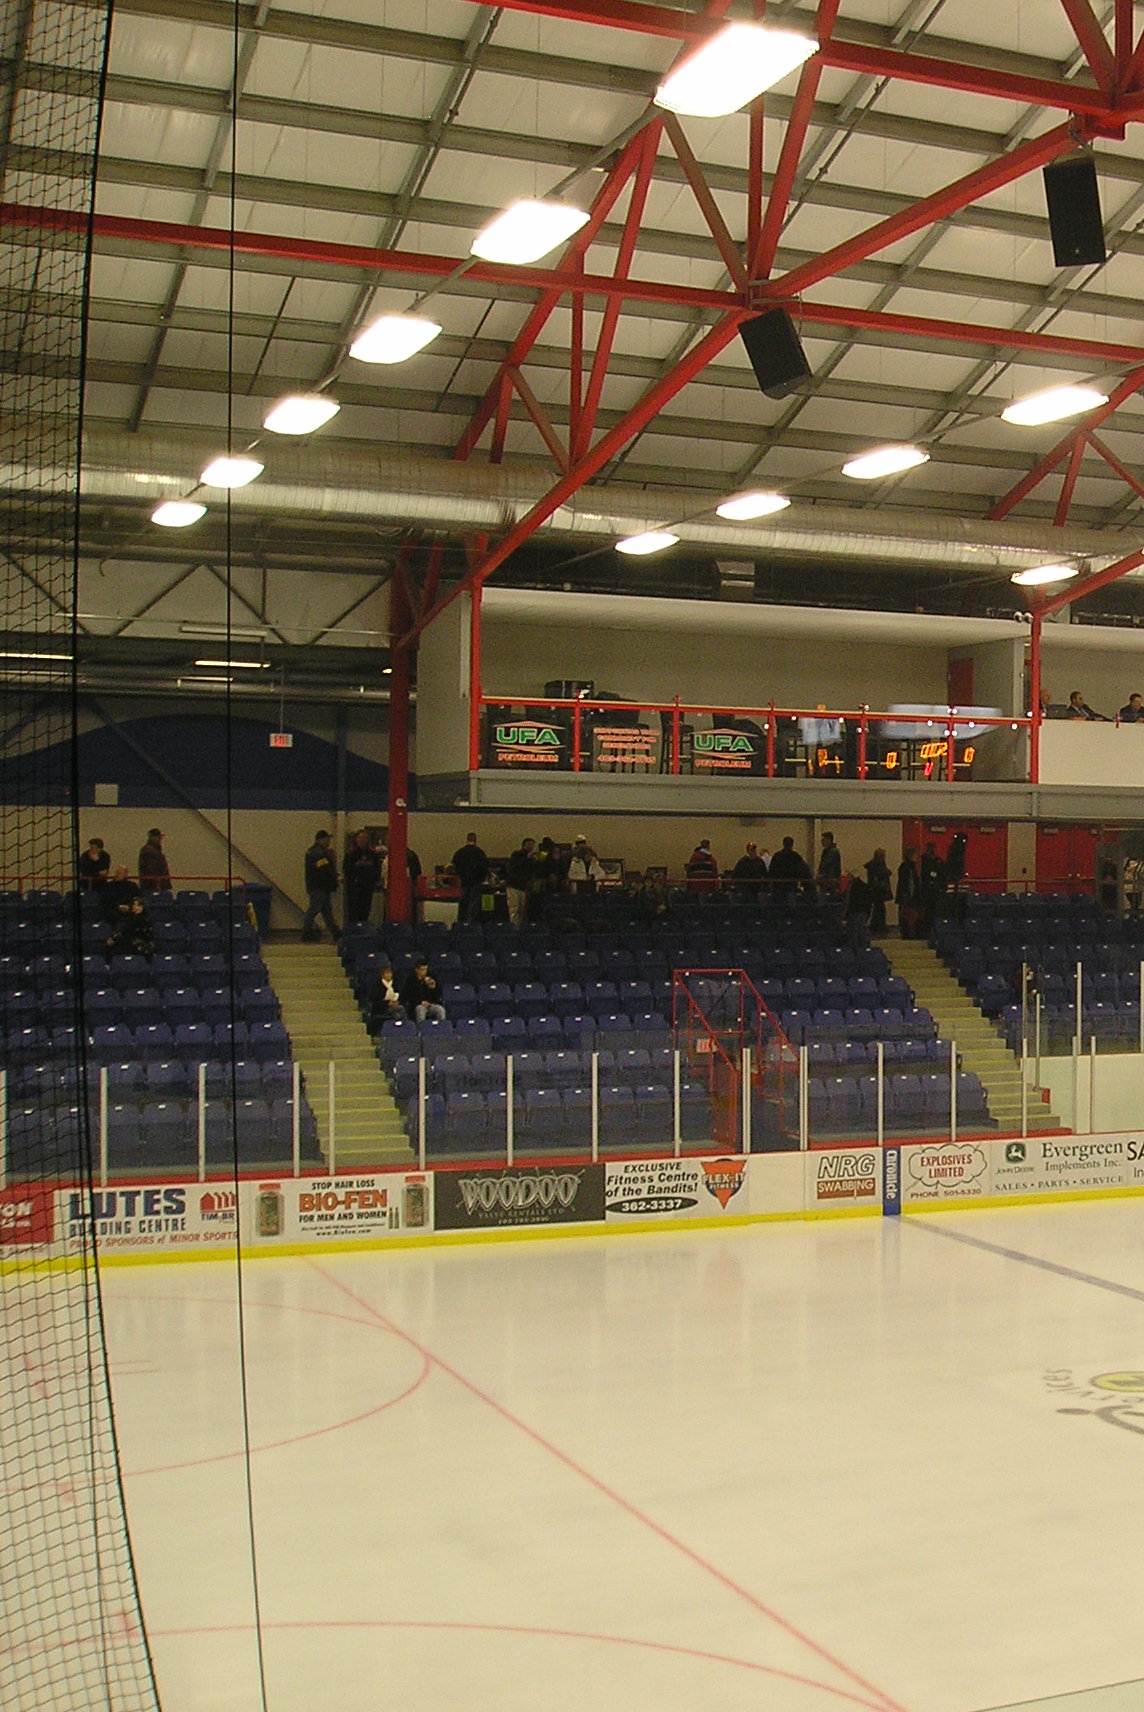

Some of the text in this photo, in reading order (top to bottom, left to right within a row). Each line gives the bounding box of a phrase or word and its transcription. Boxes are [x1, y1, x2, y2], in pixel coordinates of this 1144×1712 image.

[496, 727, 561, 745] UFA
[694, 734, 754, 752] UFA
[1042, 1142, 1123, 1161] Evergreen
[624, 1162, 682, 1173] EXCLUSIVE
[817, 1153, 876, 1179] NRG
[920, 1154, 973, 1167] EXPLOSIVES
[1045, 1160, 1101, 1173] Implements
[607, 1172, 699, 1186] Fitness Centre
[702, 1171, 746, 1185] FLEX-IT
[929, 1167, 964, 1179] LIMITED
[312, 1179, 375, 1190] STOP HAIR LOSS
[606, 1182, 698, 1198] of the Bandits!
[818, 1179, 874, 1193] SWABBING
[995, 1175, 1124, 1191] SALES PARTS SERVICE
[299, 1189, 388, 1213] BIO-FEN
[910, 1191, 940, 1199] PHONE
[70, 1188, 186, 1220] LUTES
[621, 1199, 683, 1211] 362-3337
[299, 1211, 387, 1223] FOR MEN AND WOMEN
[139, 1218, 186, 1233] CENTRE
[105, 1236, 154, 1246] SPONSORS
[170, 1233, 200, 1243] MINOR
